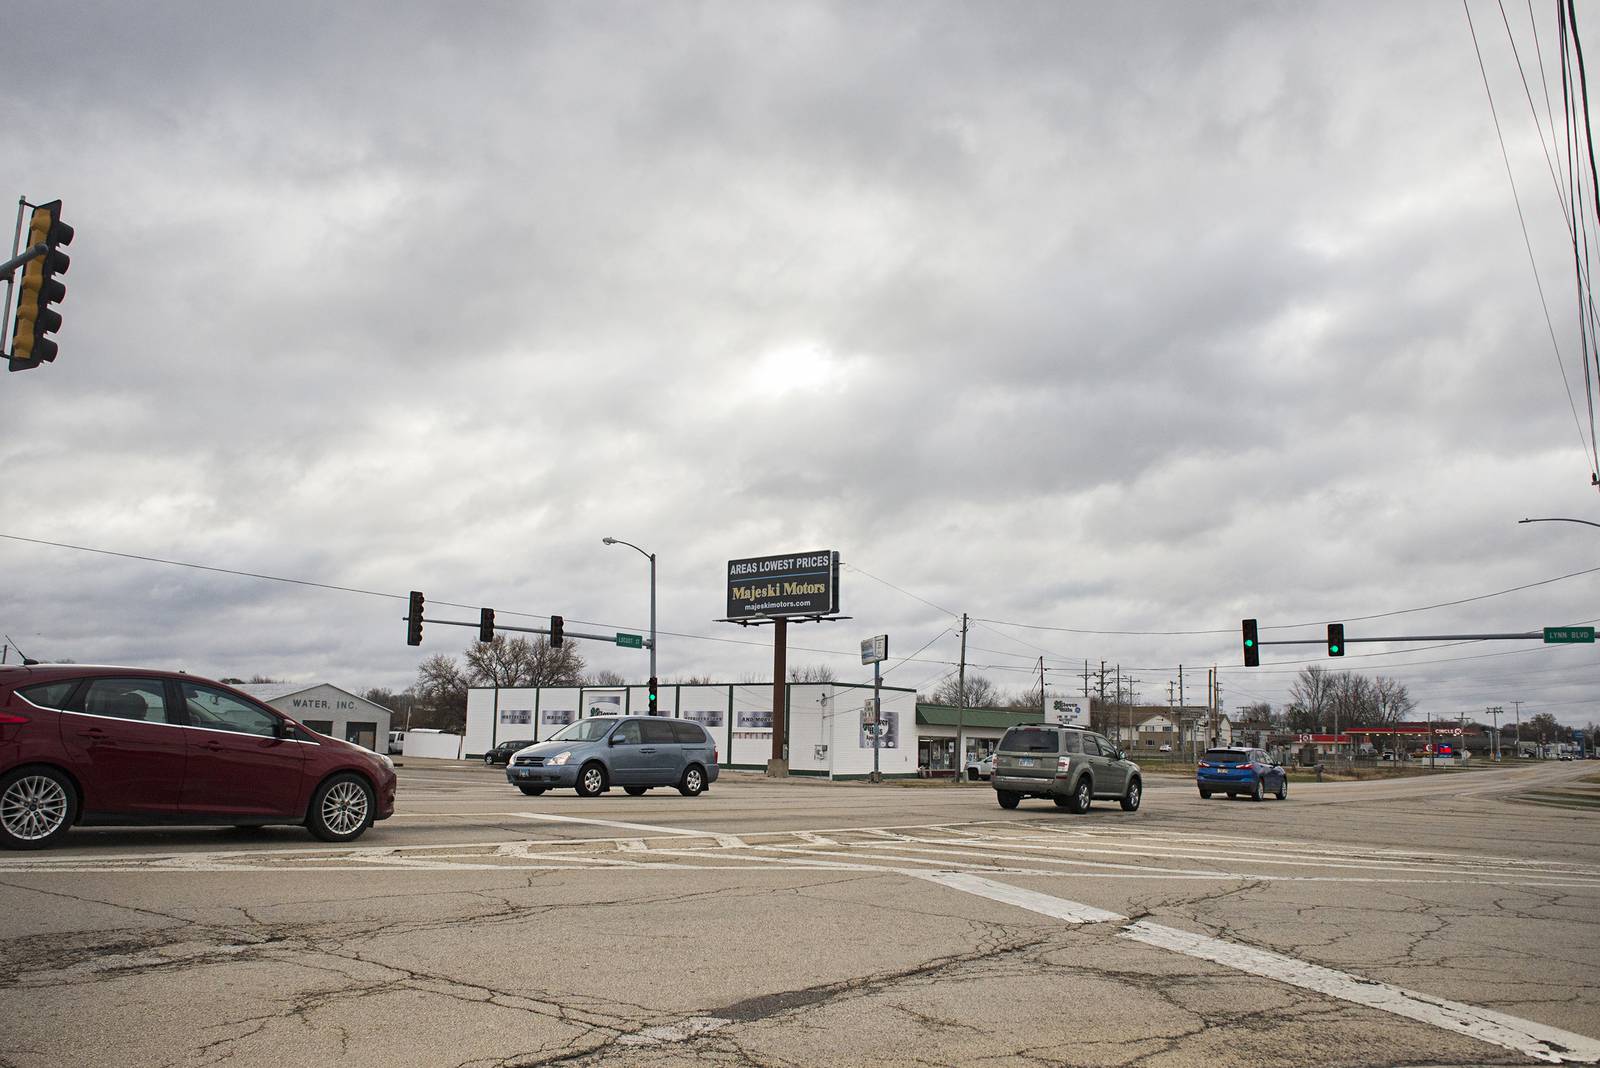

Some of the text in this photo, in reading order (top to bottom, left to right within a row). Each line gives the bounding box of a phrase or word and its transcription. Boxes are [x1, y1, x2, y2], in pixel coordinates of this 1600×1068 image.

[730, 555, 829, 575] AREAS LOWEST PRICES
[732, 582, 825, 601] Majeski Motors
[744, 600, 811, 611] majeskimotors.com
[1549, 631, 1590, 639] LYNN BLVD
[293, 699, 358, 710] WATER, INC.
